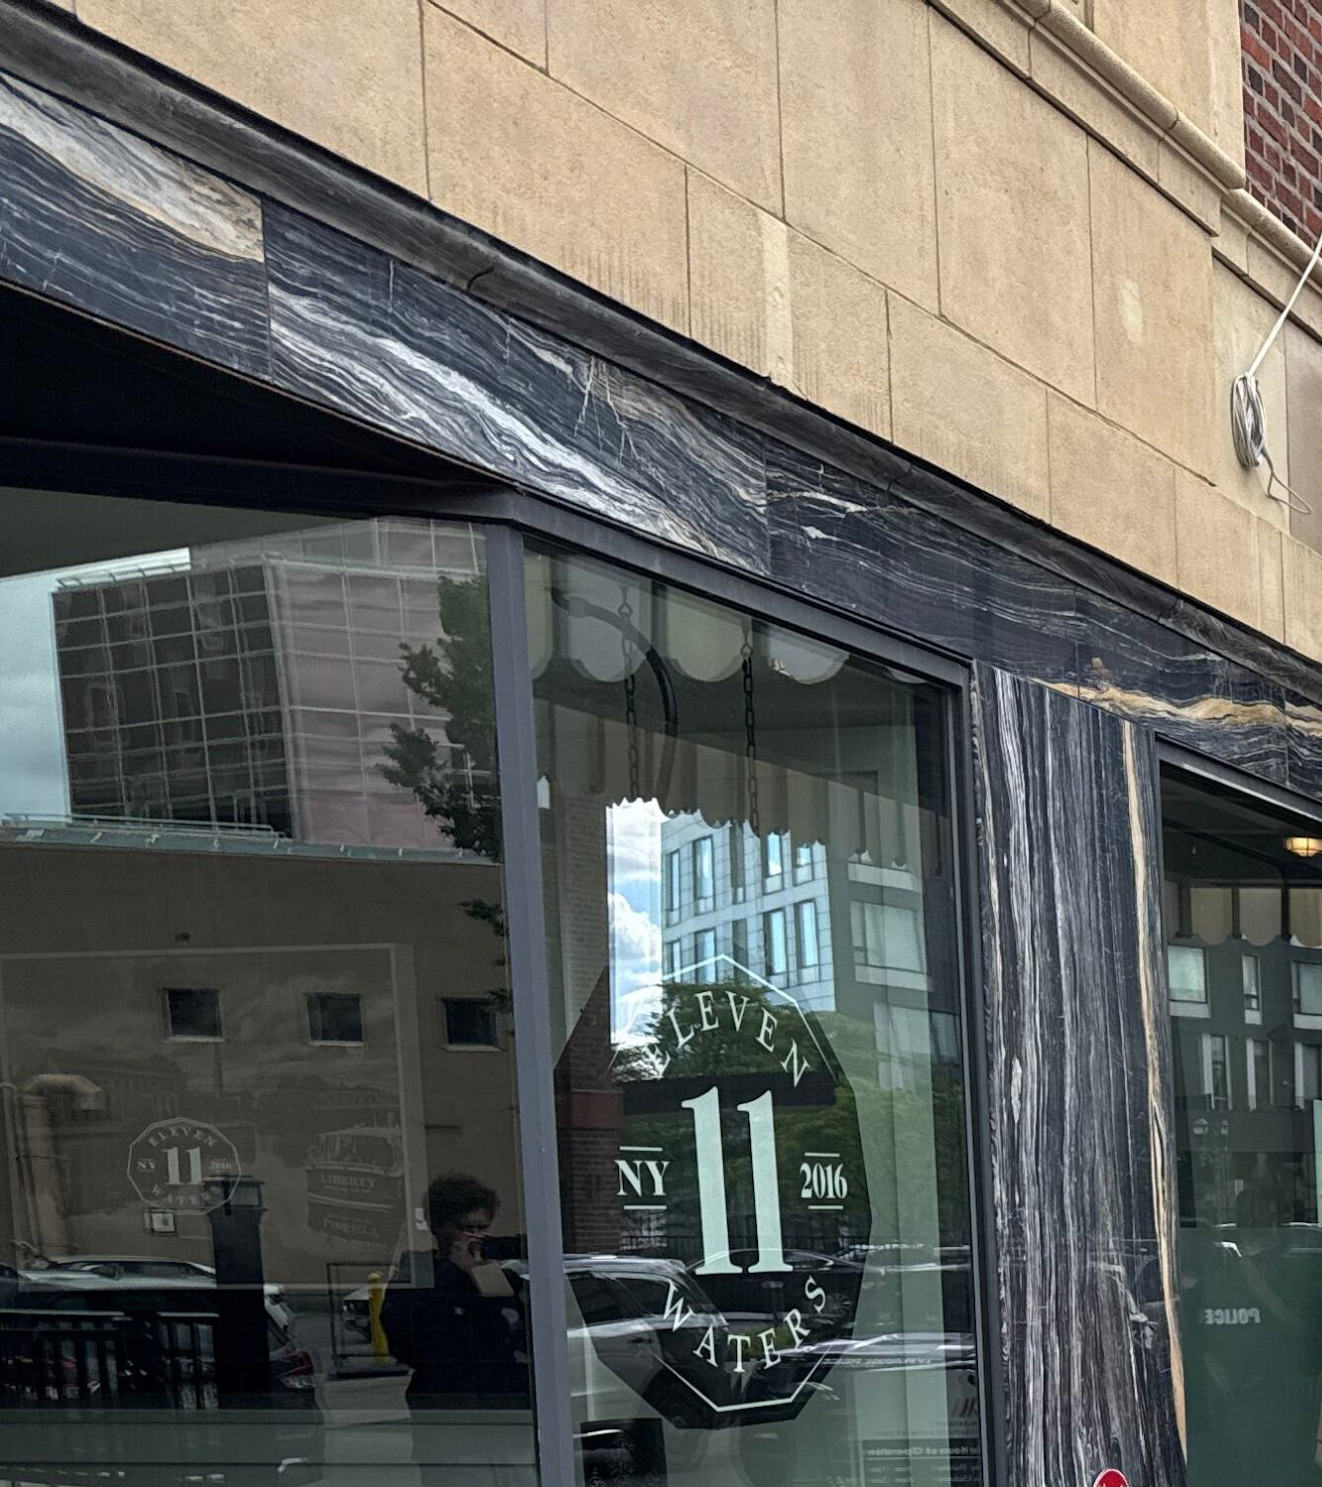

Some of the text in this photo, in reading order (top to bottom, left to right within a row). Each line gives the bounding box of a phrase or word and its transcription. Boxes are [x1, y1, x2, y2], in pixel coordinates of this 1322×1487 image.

[645, 990, 810, 1089] ELEVEN
[161, 1146, 203, 1186] 11
[614, 1159, 670, 1197] NY
[681, 1086, 793, 1275] 11
[800, 1161, 848, 1200] 2016
[662, 1275, 826, 1374] WATERS
